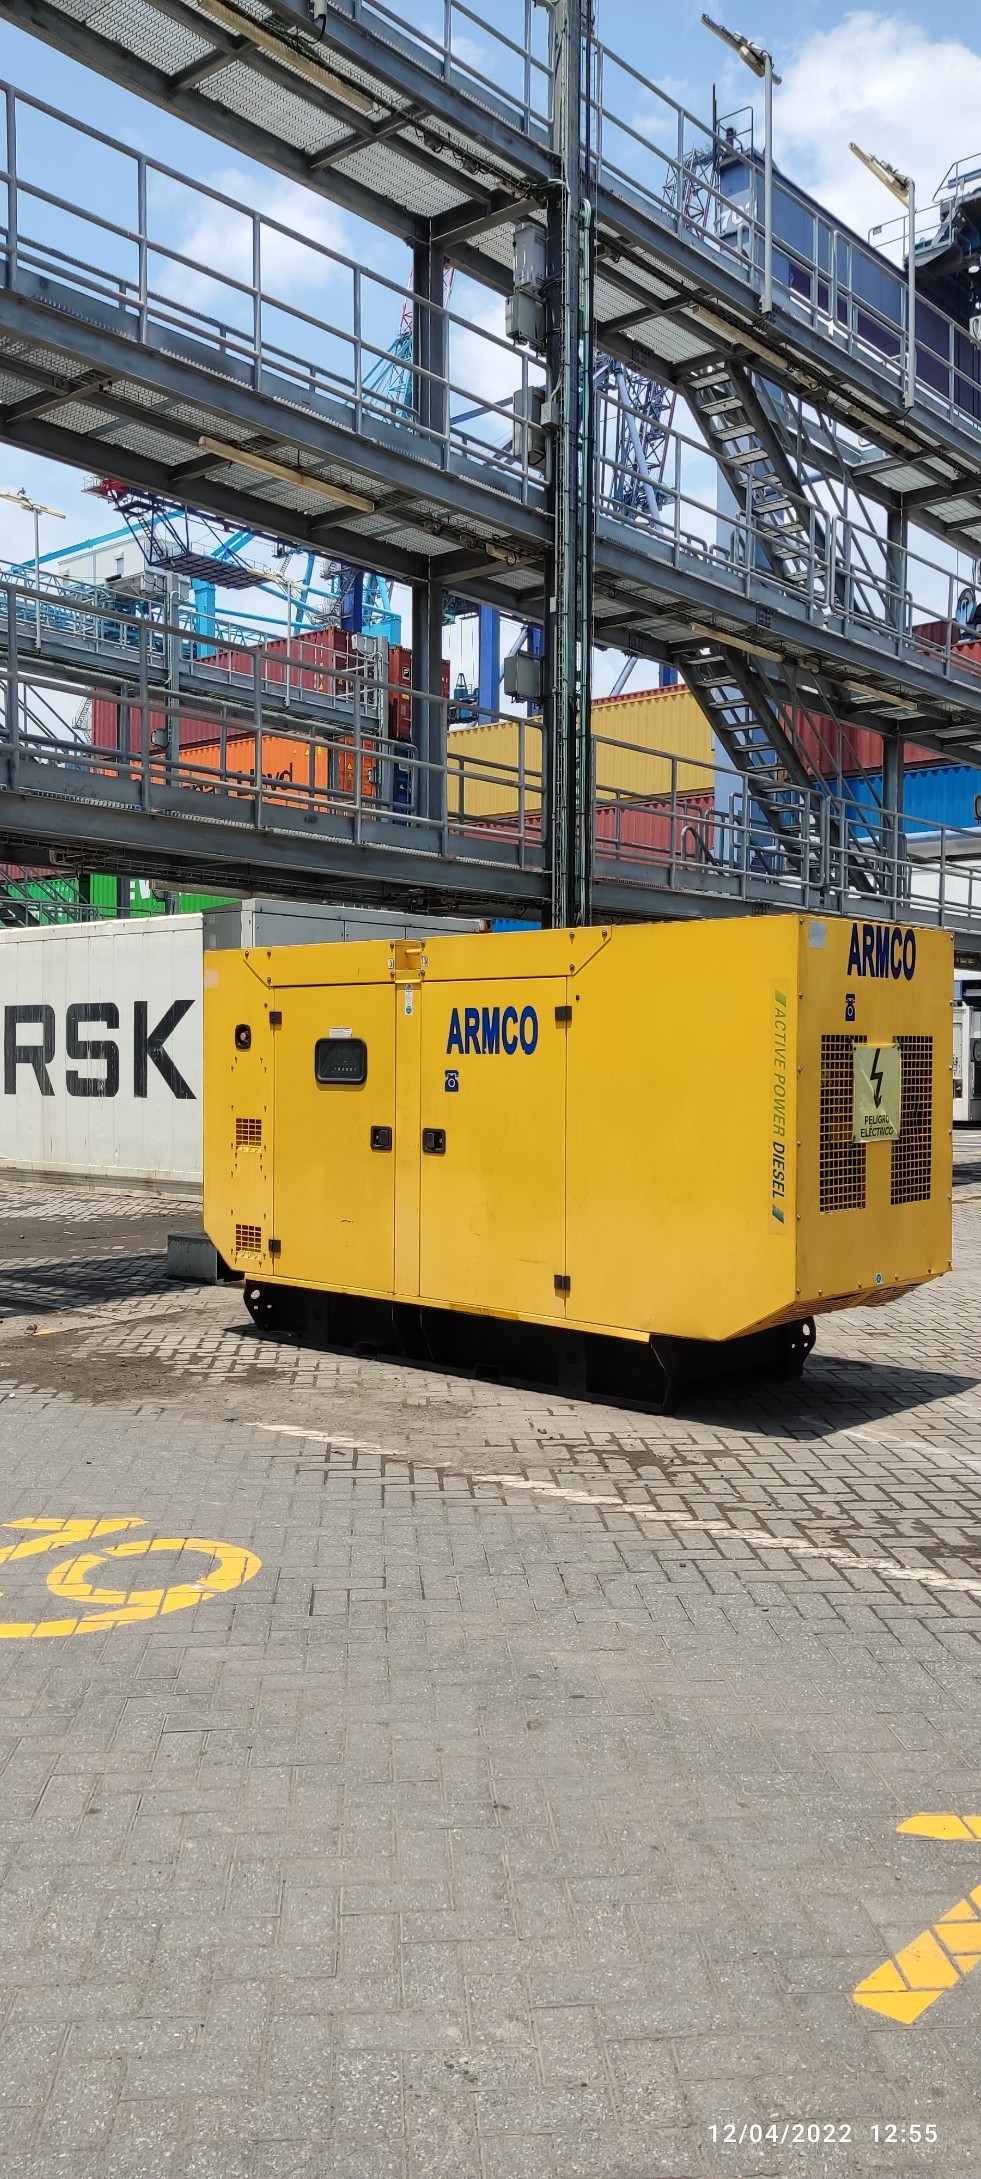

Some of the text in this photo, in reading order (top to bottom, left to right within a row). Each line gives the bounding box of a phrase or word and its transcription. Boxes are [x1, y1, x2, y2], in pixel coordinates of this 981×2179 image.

[847, 922, 916, 981] ARMCO
[4, 1000, 197, 1099] RSK
[446, 1005, 538, 1055] ARMCO
[772, 1007, 786, 1199] ACTIVE POWER DIESEL
[864, 1114, 890, 1125] PELIGRO
[860, 1124, 894, 1138] ELÉCTRICO
